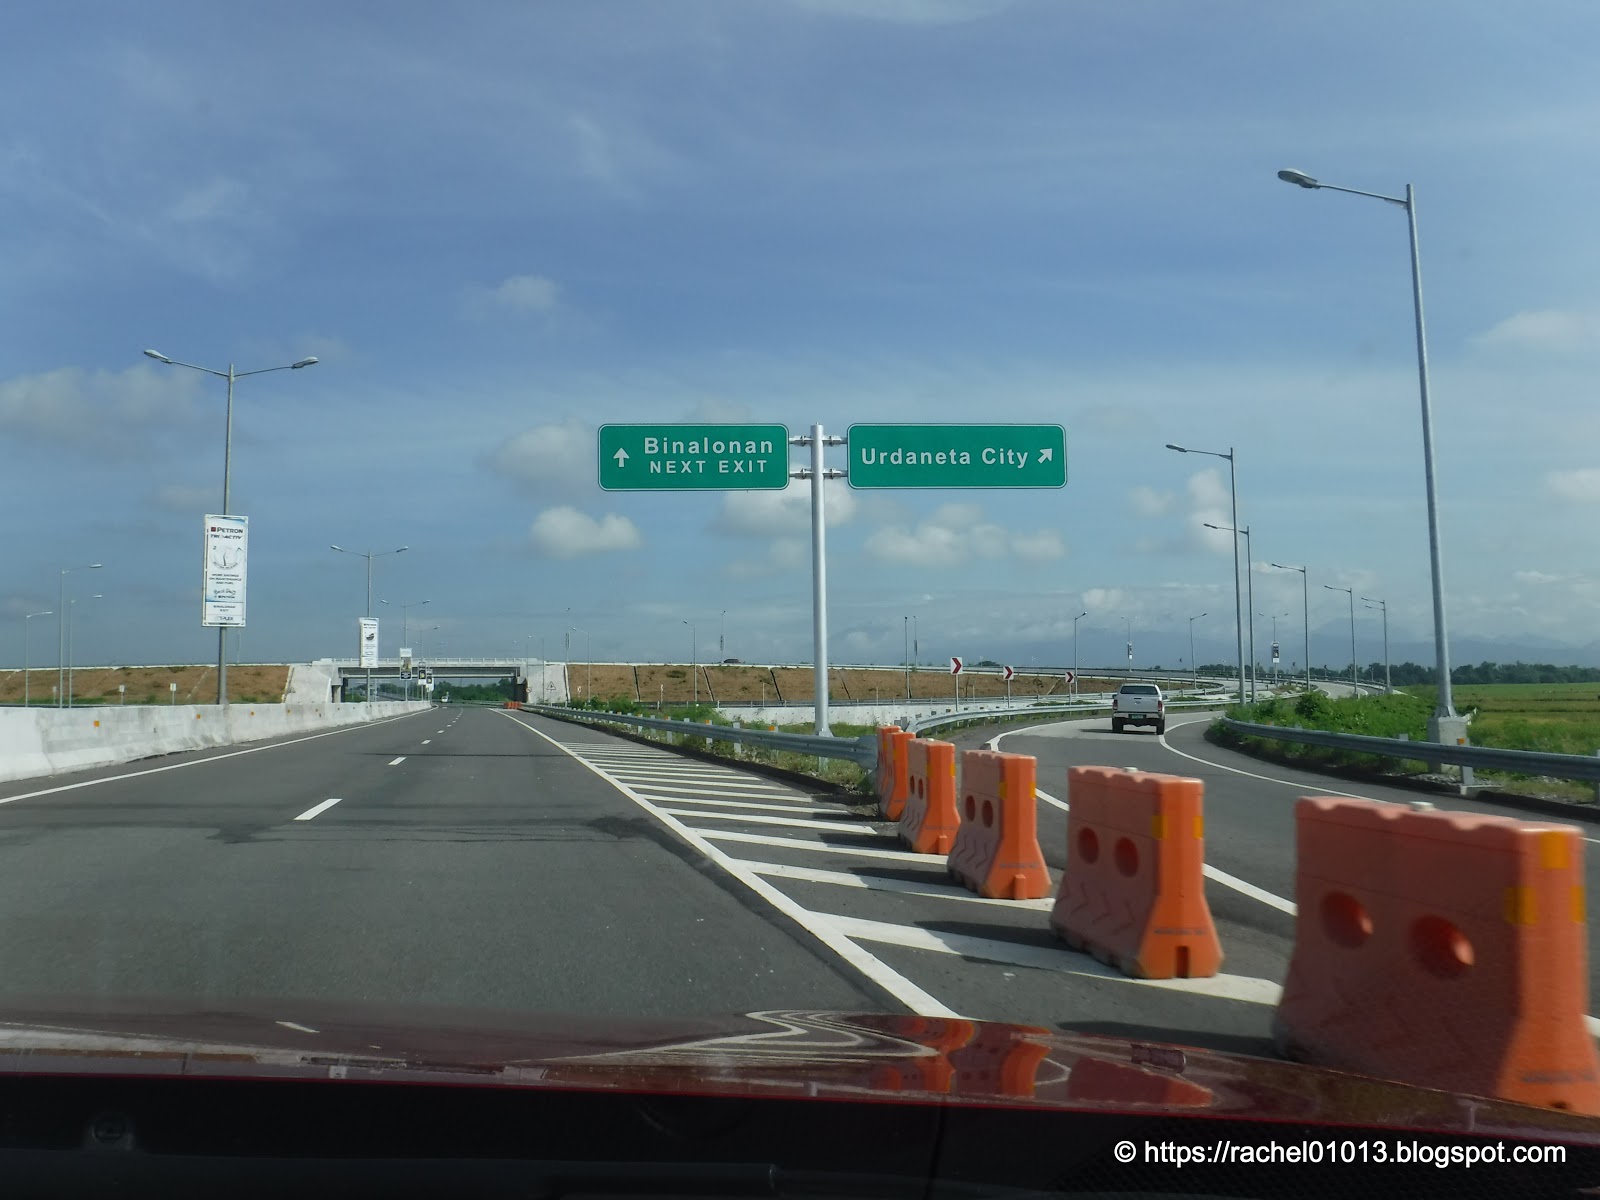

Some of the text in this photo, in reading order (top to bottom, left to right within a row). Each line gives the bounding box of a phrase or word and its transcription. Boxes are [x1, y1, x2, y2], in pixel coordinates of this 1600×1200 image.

[644, 437, 773, 454] Binalonan
[861, 448, 1029, 469] Urdaneta City
[650, 460, 768, 474] NEXT EXIT
[217, 526, 243, 534] PETRON
